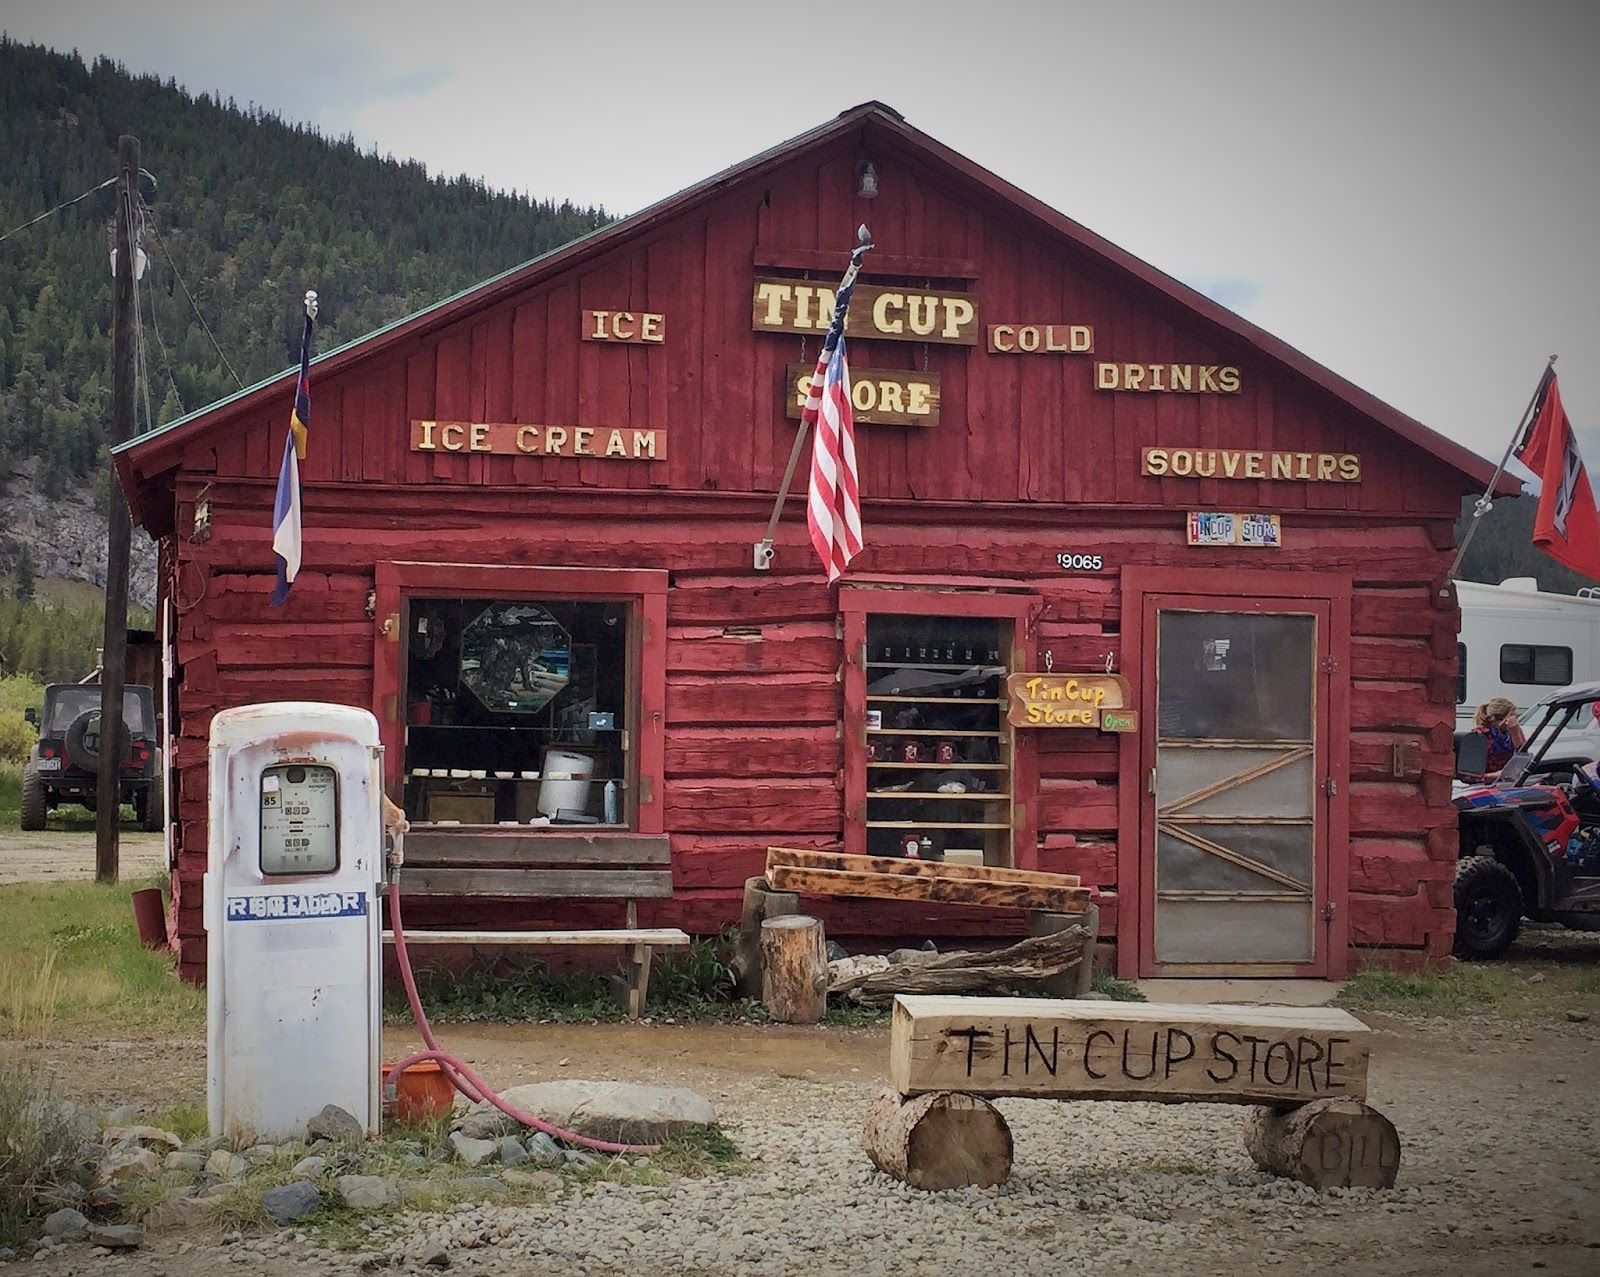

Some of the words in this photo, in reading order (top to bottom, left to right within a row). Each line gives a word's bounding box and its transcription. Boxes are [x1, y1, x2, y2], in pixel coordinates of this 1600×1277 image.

[758, 283, 848, 330] TIN
[873, 293, 974, 338] CUP
[591, 311, 664, 342] ICE
[993, 325, 1091, 353] COLD
[1098, 363, 1241, 393] DRINKS
[797, 375, 931, 415] SORE
[418, 421, 493, 451] ICE
[516, 426, 657, 458] CREAM
[1146, 449, 1360, 481] SOUVENIRS
[1243, 522, 1277, 538] STORE
[1057, 553, 1103, 570] 19065
[1026, 703, 1094, 724] Store
[1104, 714, 1131, 730] Open
[945, 1024, 1059, 1077] TIN
[1083, 1029, 1197, 1080] CUP
[1206, 1030, 1351, 1092] STORE
[1320, 1131, 1395, 1174] BILL
